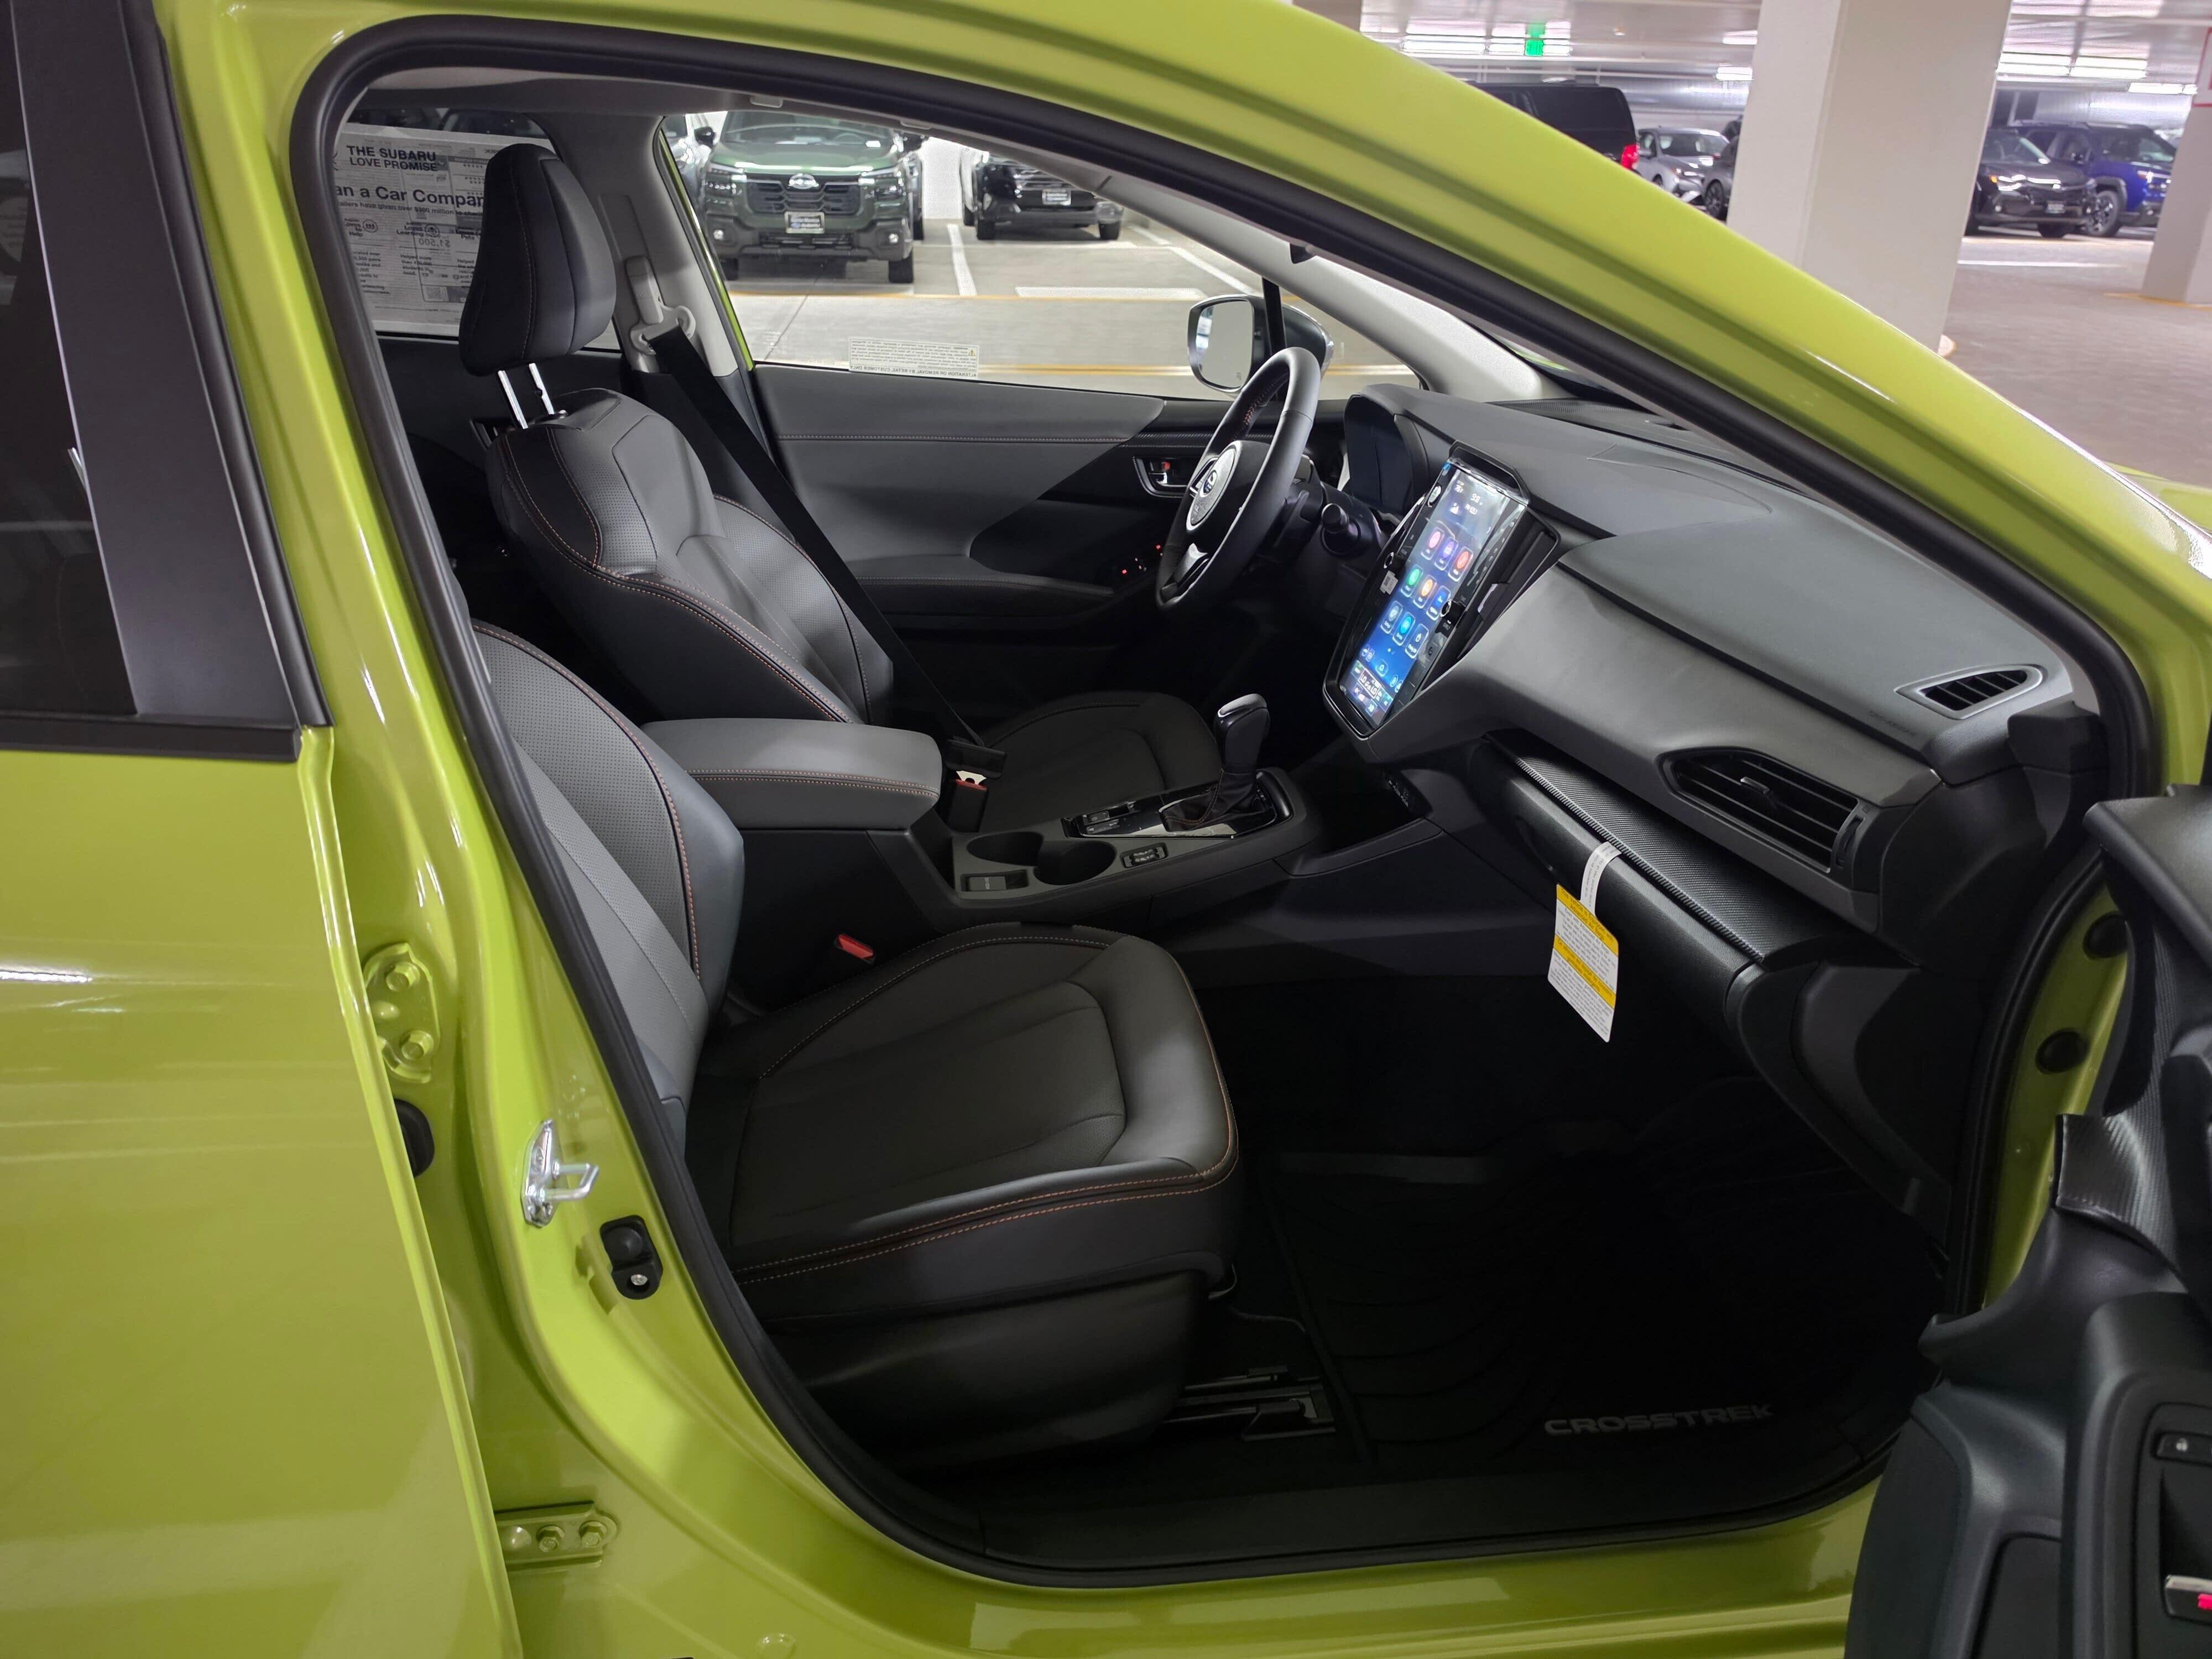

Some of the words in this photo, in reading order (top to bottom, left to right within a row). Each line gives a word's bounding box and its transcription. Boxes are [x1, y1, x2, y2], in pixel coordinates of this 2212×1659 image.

[347, 145, 375, 156] THE
[379, 148, 436, 161] SUBARU
[349, 157, 381, 168] LOVE
[384, 160, 439, 171] PROMISE
[360, 187, 370, 197] a
[375, 186, 407, 201] Car
[397, 229, 424, 237] Learning
[1544, 1405, 1775, 1436] CROSSTREK
